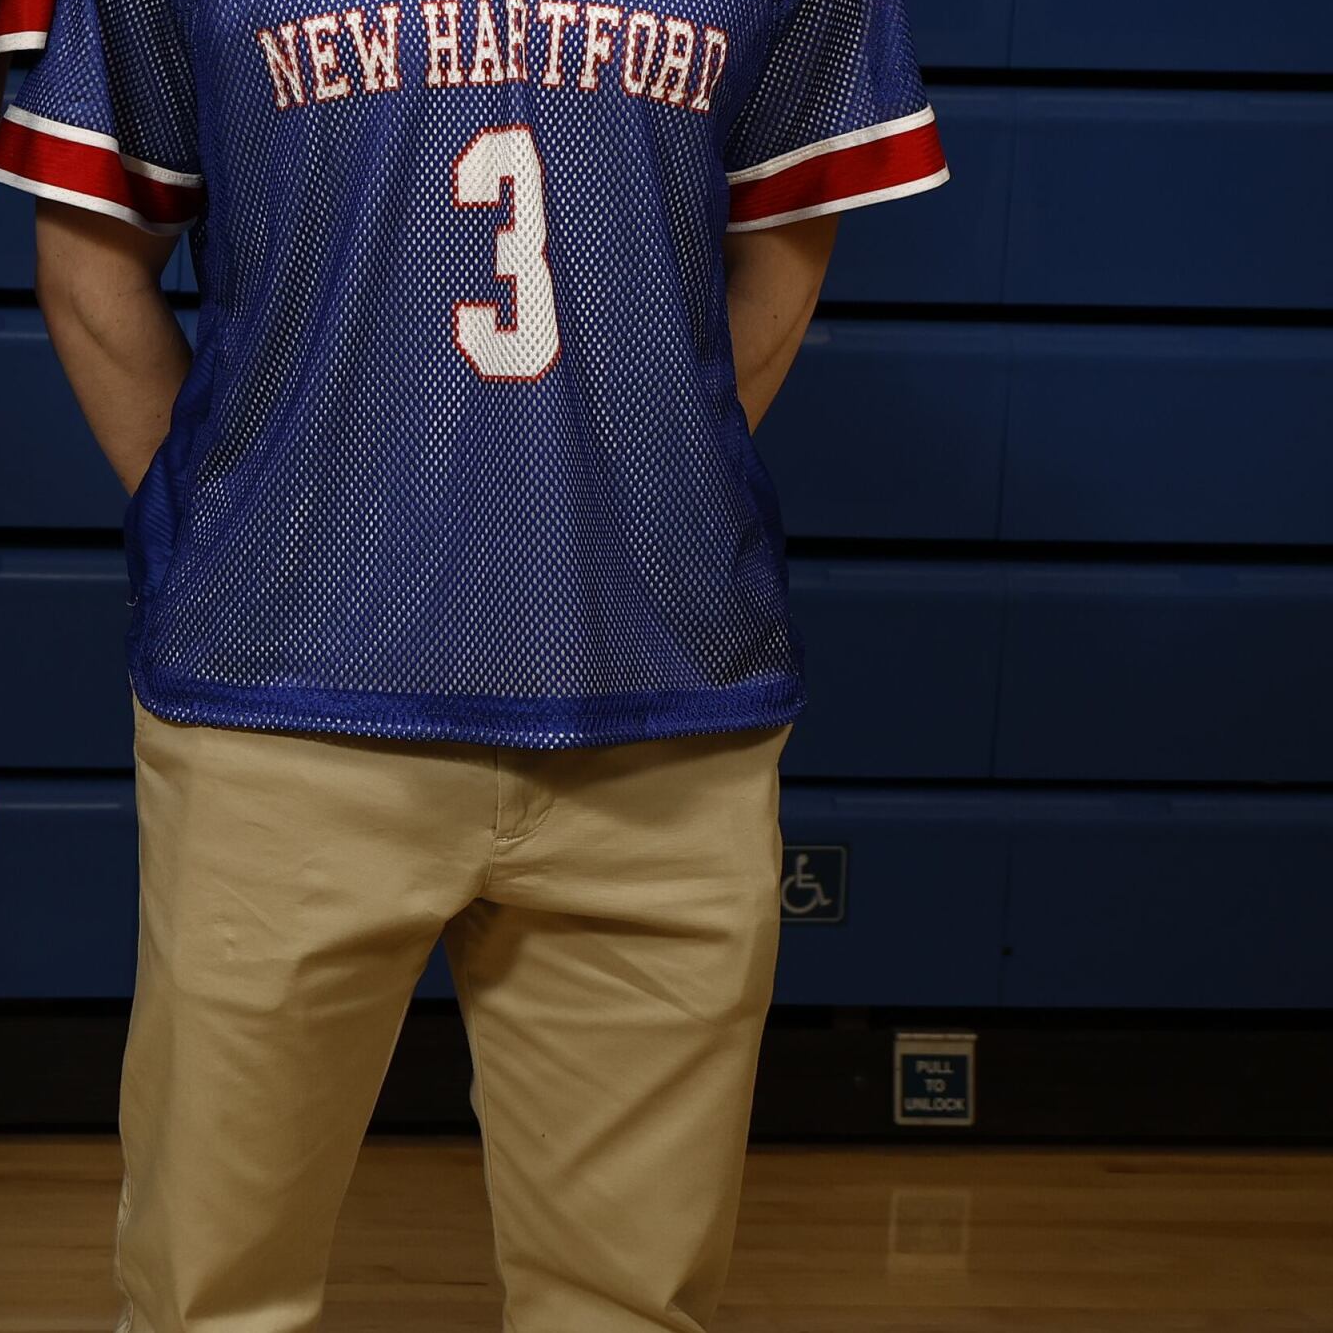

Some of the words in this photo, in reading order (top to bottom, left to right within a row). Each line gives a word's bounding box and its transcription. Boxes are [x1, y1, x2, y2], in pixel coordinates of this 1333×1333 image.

[256, 1, 402, 112] NEW
[451, 123, 563, 384] 3
[915, 1059, 954, 1074] PULL
[924, 1078, 947, 1093] TO
[904, 1097, 966, 1111] UNLOCK
